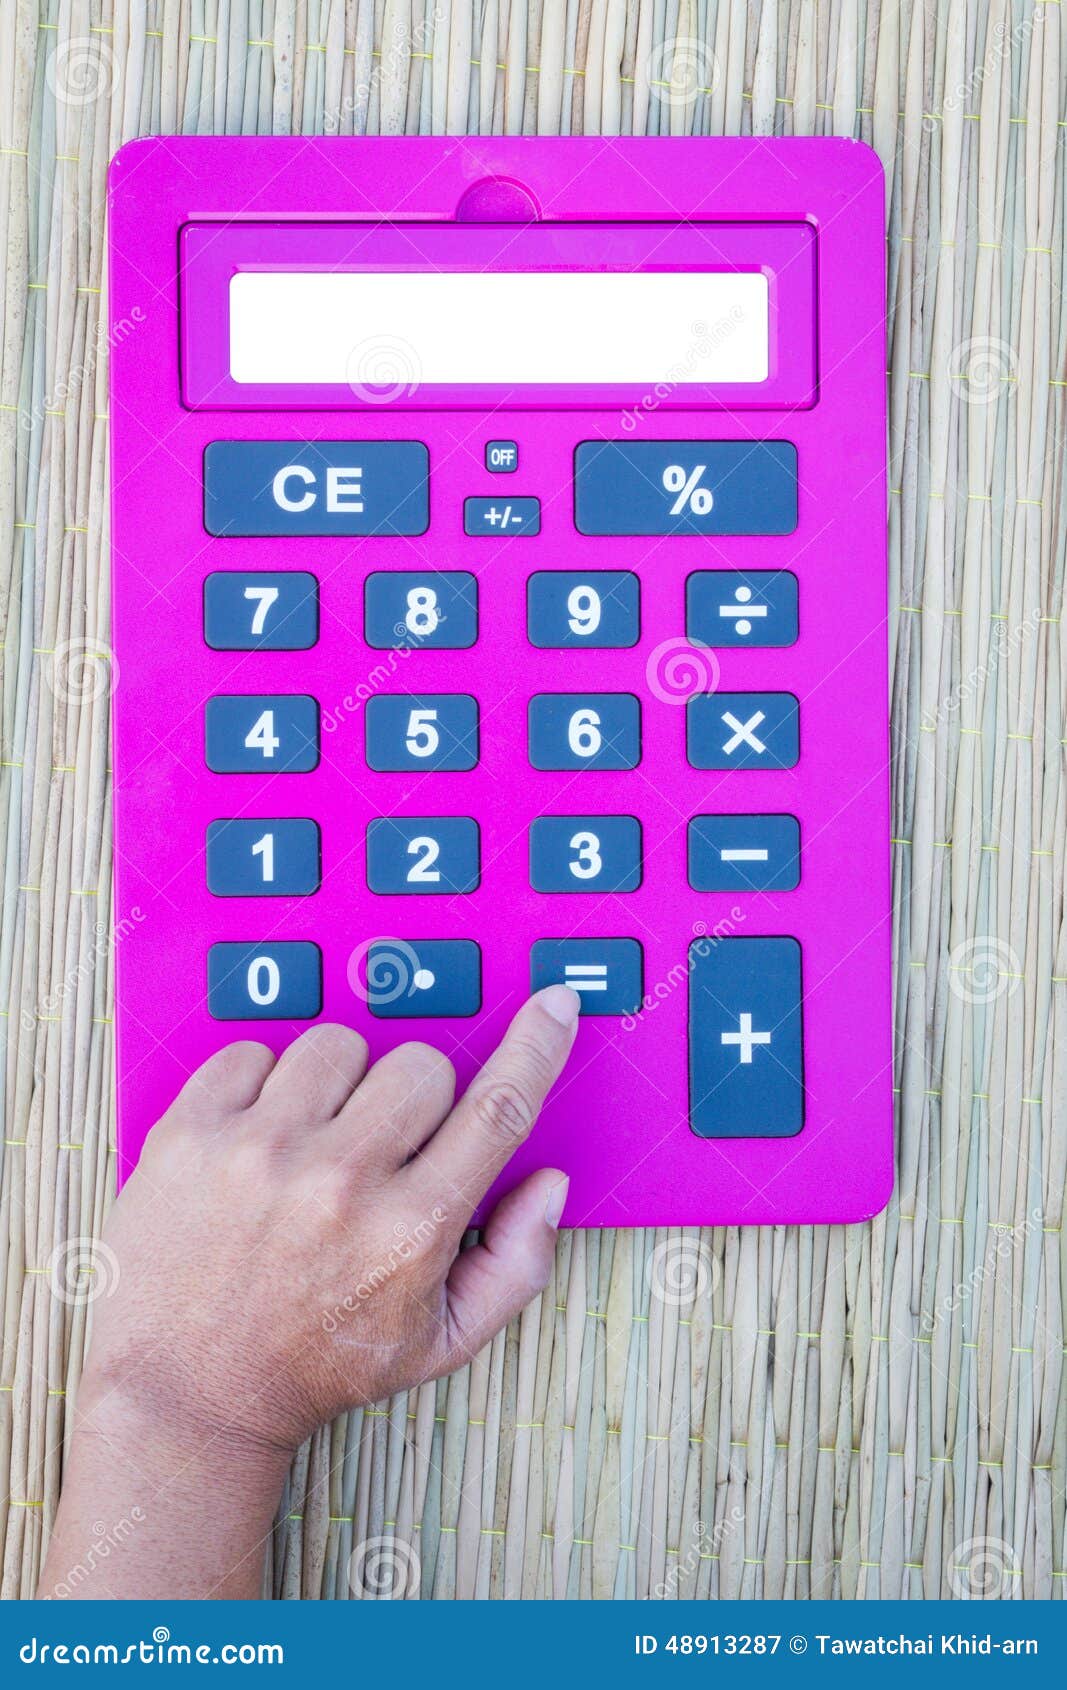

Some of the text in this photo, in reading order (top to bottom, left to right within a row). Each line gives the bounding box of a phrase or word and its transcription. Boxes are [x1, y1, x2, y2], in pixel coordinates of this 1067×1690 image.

[491, 448, 514, 465] OFF
[272, 465, 364, 513] CE
[662, 465, 714, 515] %
[243, 587, 279, 635] 7
[405, 587, 439, 636] 8
[567, 585, 601, 635] 9
[244, 710, 280, 757] 4
[405, 709, 439, 757] 5
[568, 709, 602, 757] 6
[252, 833, 274, 882] 1
[406, 836, 440, 882] 2
[569, 831, 602, 879] 3
[247, 956, 280, 1005] 0
[721, 1013, 771, 1064] +
